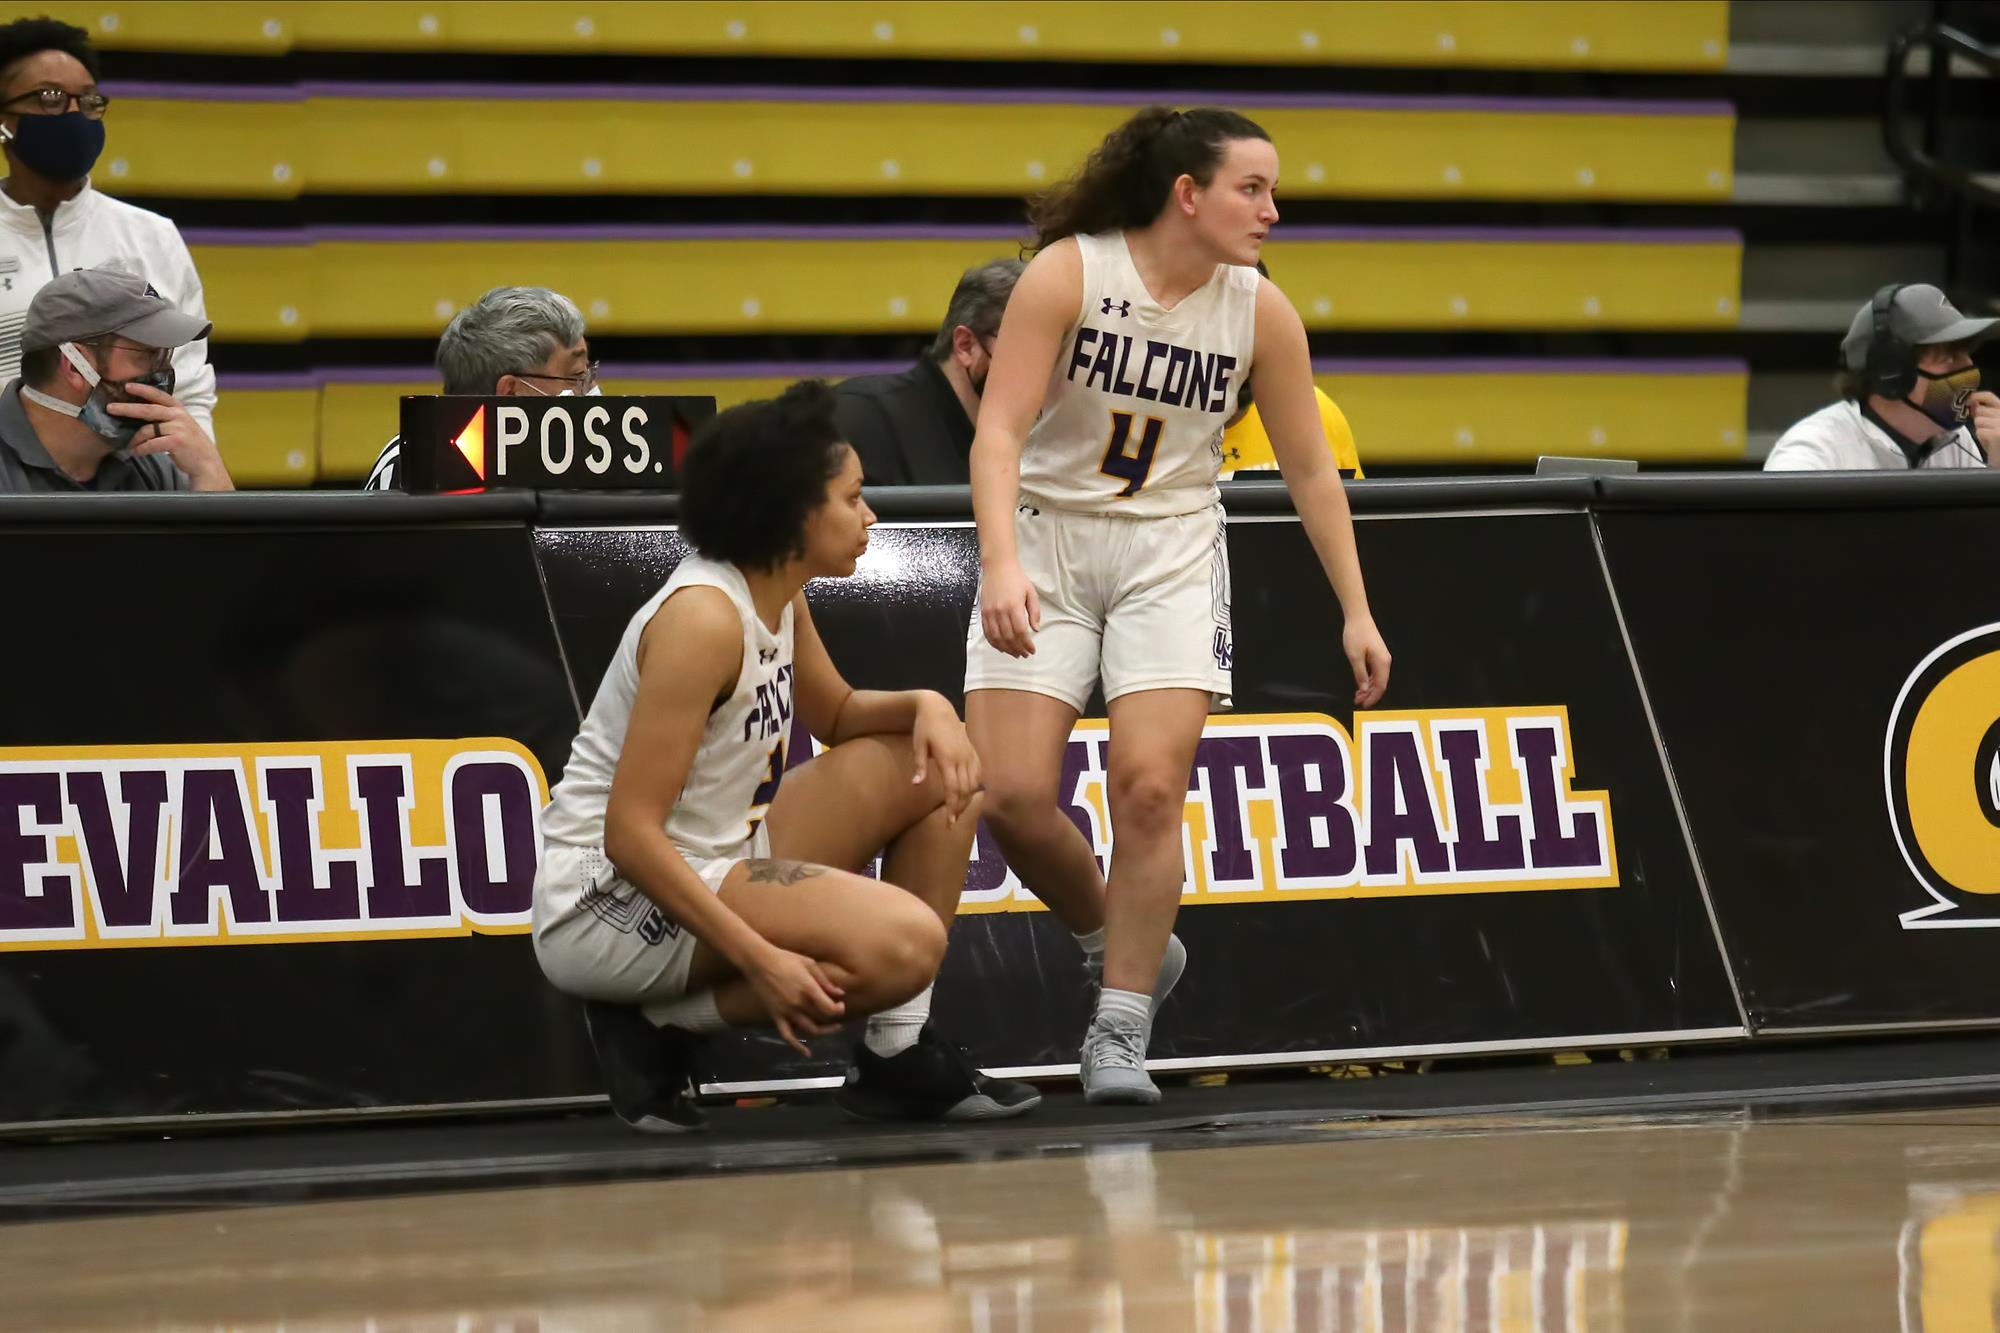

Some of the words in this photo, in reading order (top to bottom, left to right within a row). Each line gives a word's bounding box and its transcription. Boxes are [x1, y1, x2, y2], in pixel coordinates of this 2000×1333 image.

[1067, 326, 1237, 413] FALCONS
[496, 406, 663, 476] POSS.
[1097, 409, 1167, 499] 4
